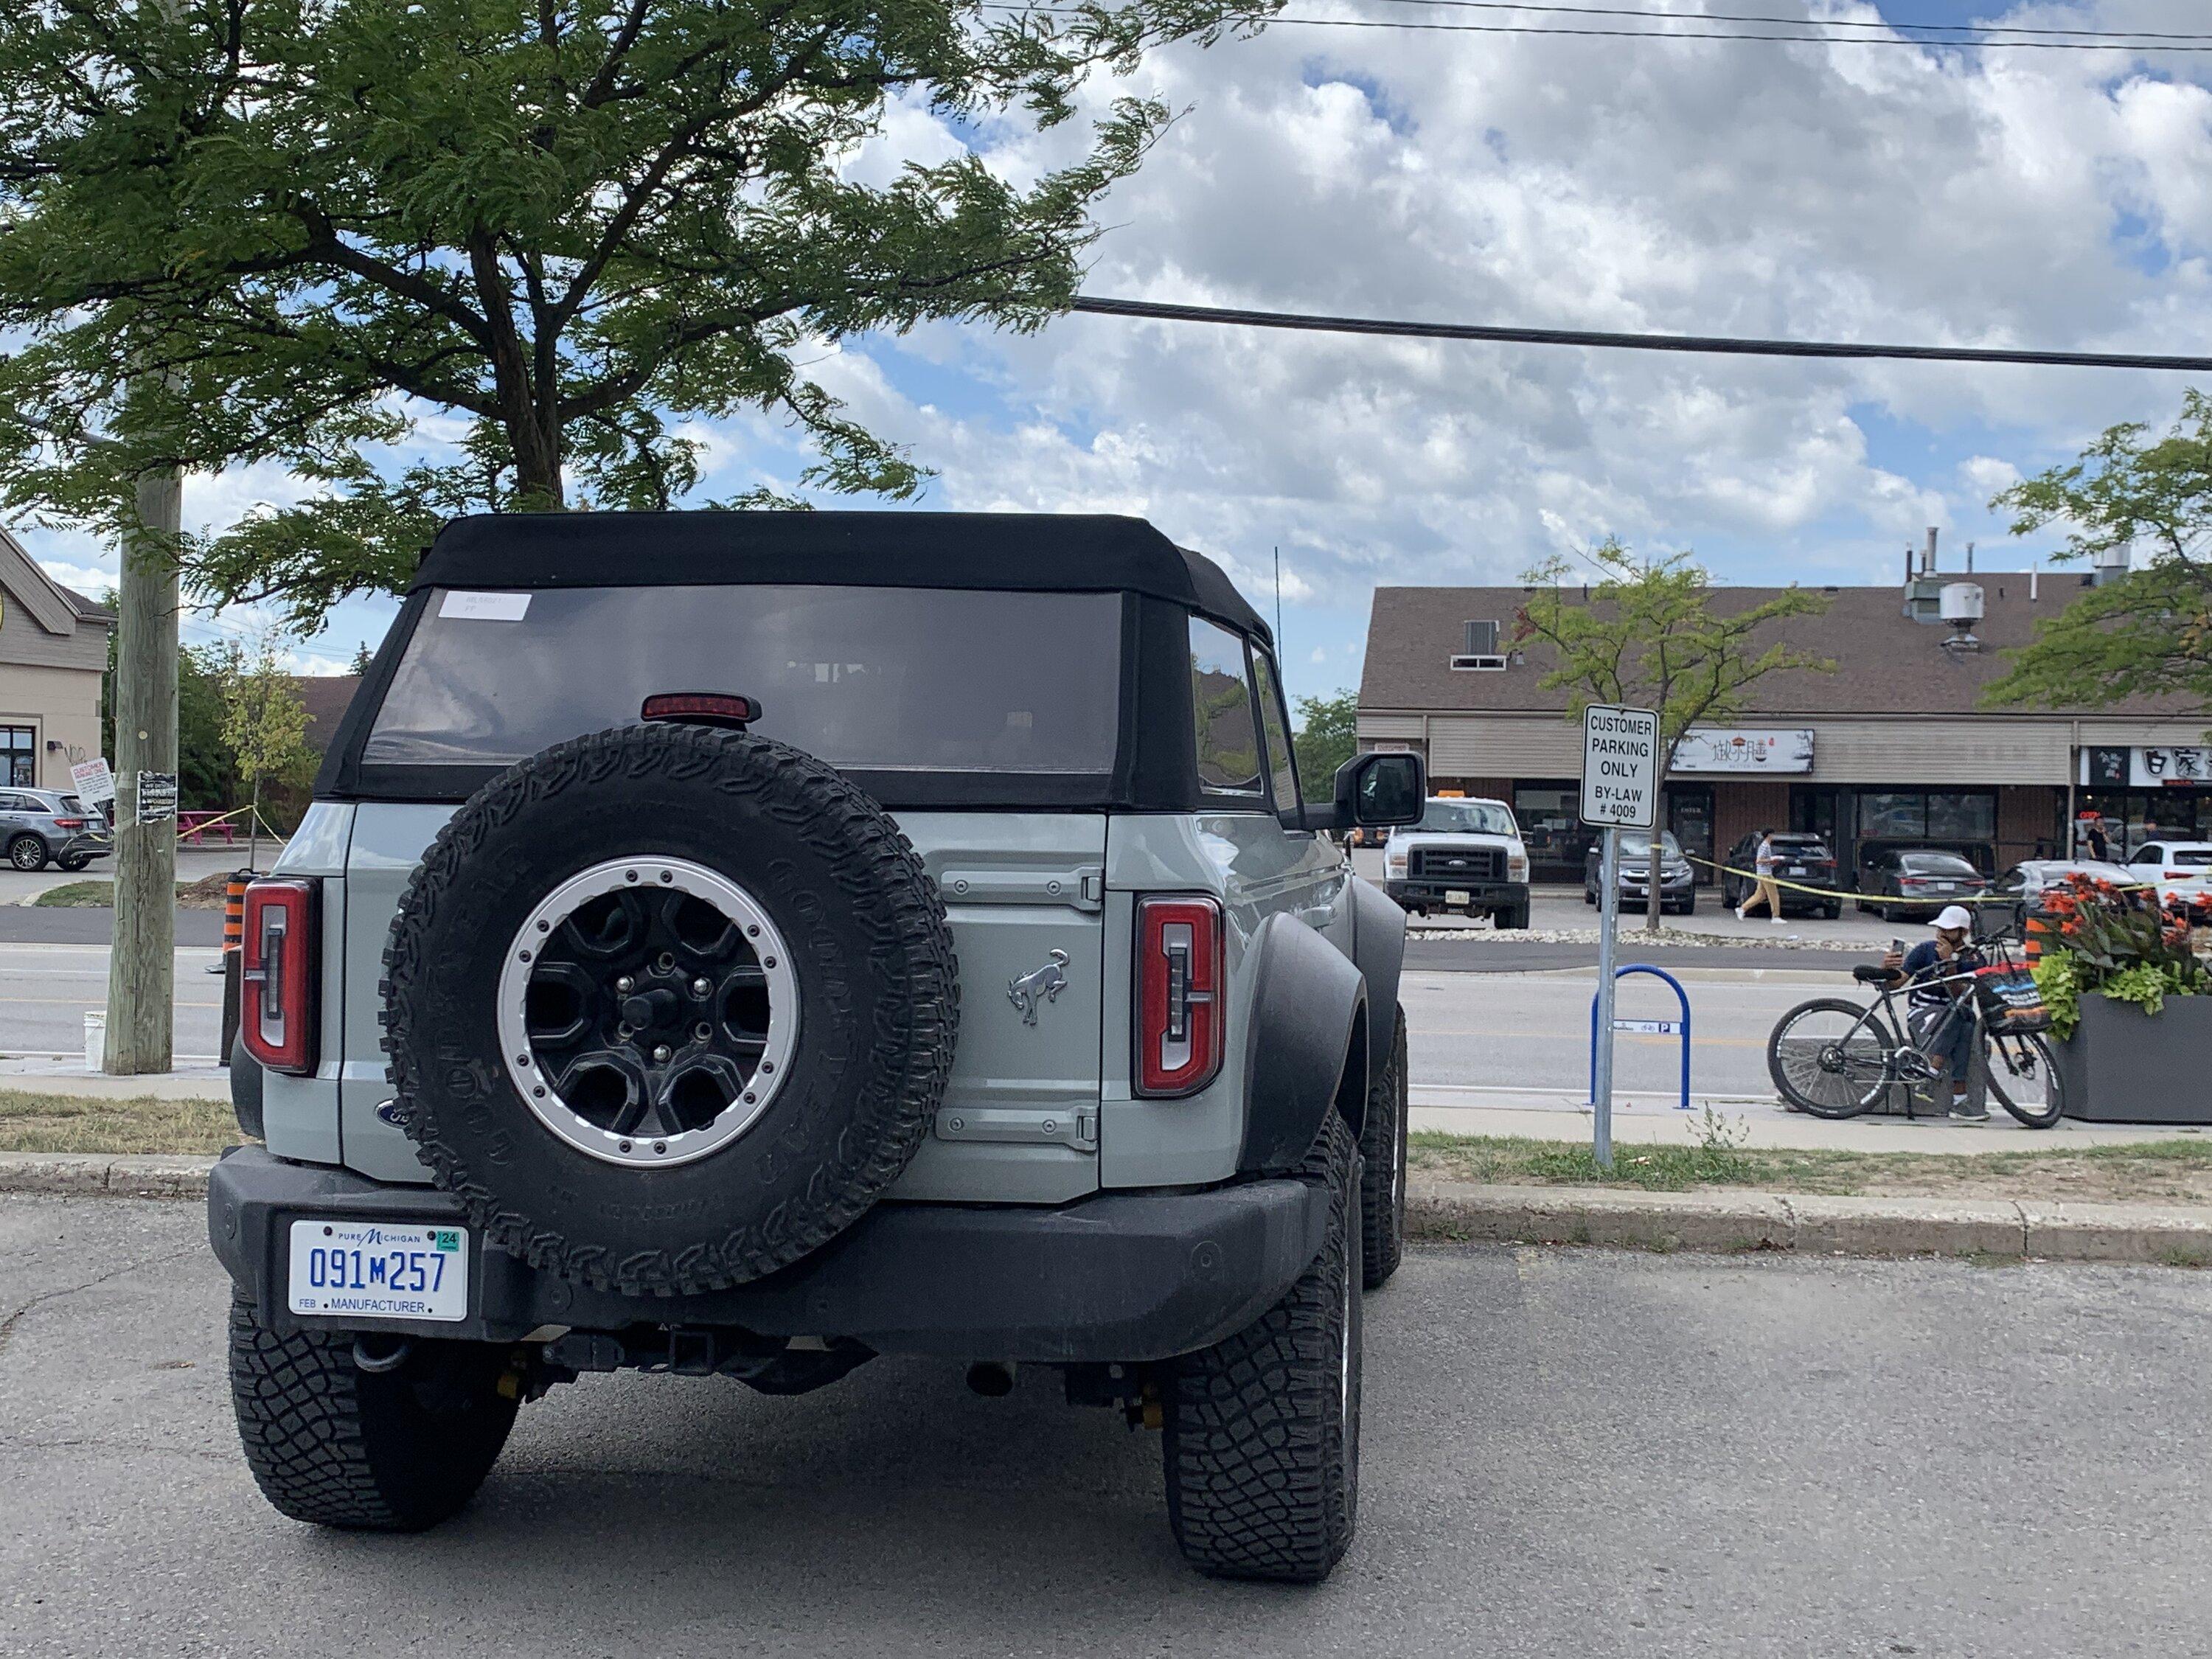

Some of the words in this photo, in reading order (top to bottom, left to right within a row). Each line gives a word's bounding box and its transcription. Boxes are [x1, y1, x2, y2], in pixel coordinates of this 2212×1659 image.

[1590, 715, 1652, 736] CUSTOMER
[1592, 738, 1649, 757] PARKING
[1601, 760, 1638, 778] ONLY
[1595, 785, 1643, 802] BY-LAW
[1599, 804, 1607, 815] #
[1610, 804, 1636, 818] 4009
[338, 1232, 361, 1241] PURE
[358, 1228, 421, 1247] MICHIGAN
[442, 1234, 457, 1244] 24
[310, 1248, 446, 1292] 091M257
[299, 1298, 316, 1308] FEB
[331, 1298, 425, 1312] MANUFACTURER
